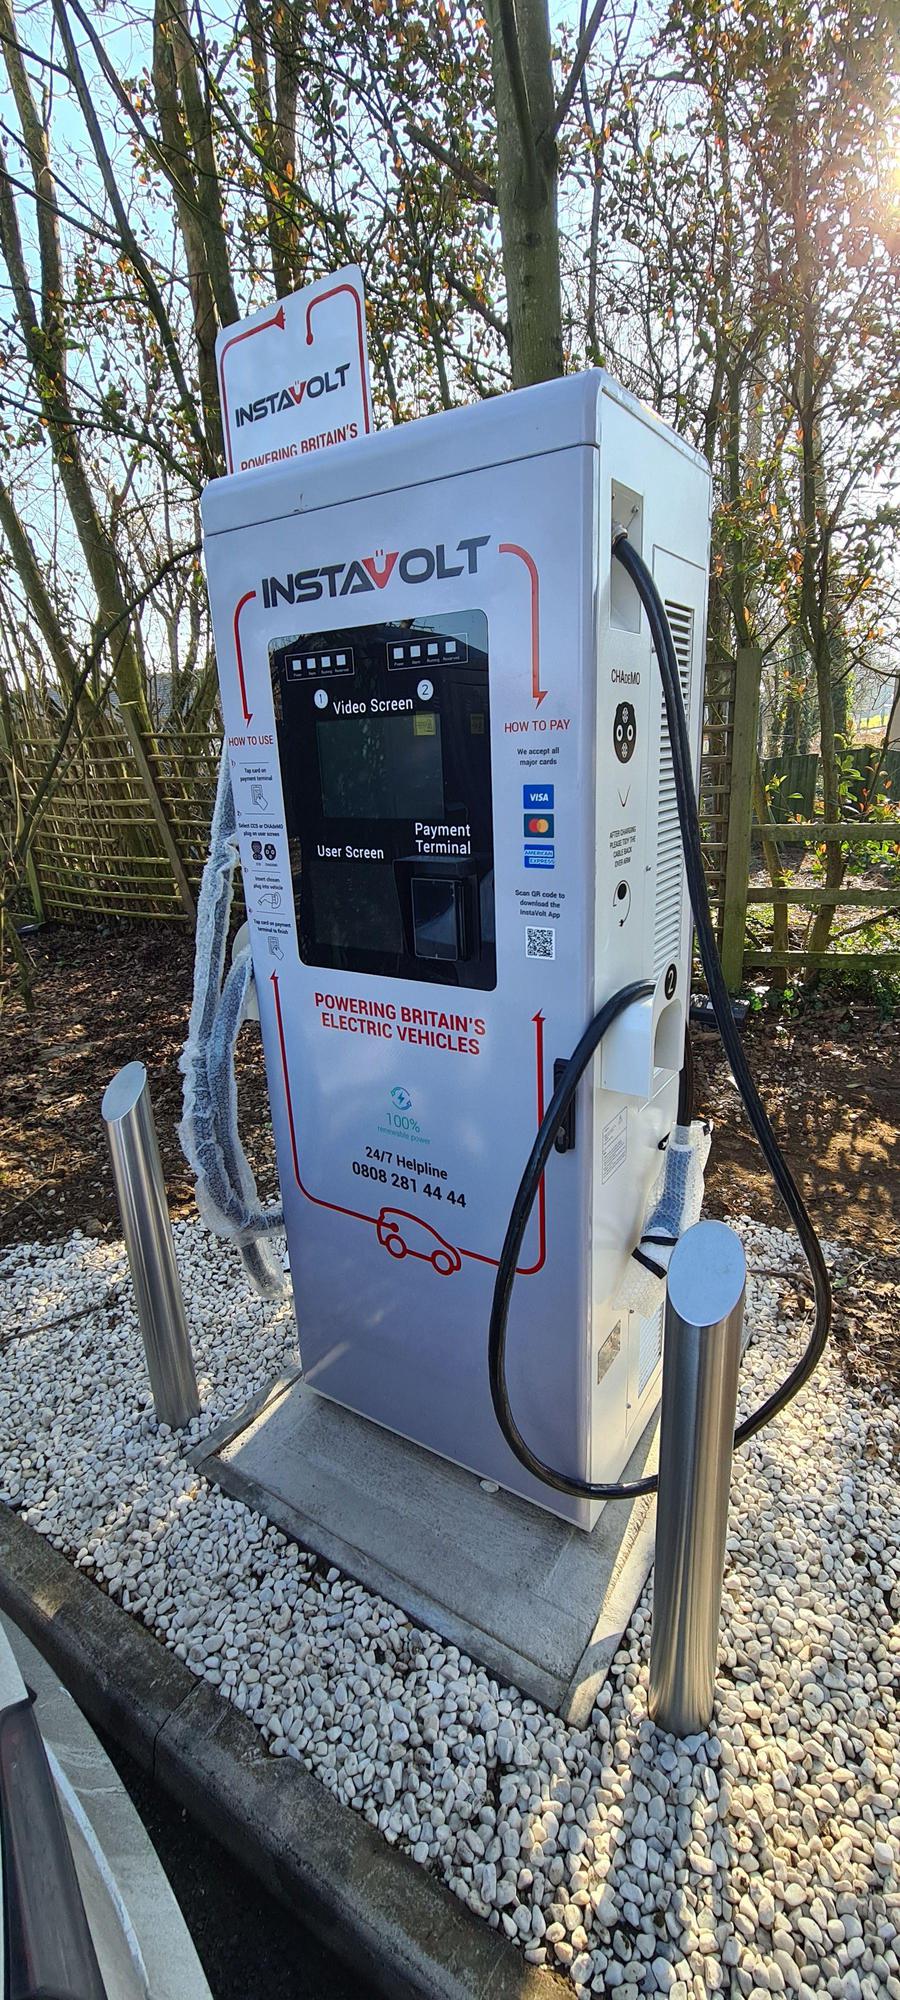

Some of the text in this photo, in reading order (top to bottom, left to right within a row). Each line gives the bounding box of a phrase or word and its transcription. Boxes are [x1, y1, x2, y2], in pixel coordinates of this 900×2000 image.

[235, 363, 350, 427] INSTAVOLT
[300, 423, 358, 453] BRITAIN'S
[261, 535, 491, 608] INSTAVOLT
[422, 684, 429, 695] 2
[333, 698, 413, 715] Video Screen
[504, 719, 571, 733] HOW TO PAY
[228, 735, 274, 746] HOW TO USE
[530, 794, 548, 802] VISA
[415, 822, 470, 839] Payment
[317, 845, 384, 859] User Screen
[415, 840, 471, 855] Terminal
[542, 891, 557, 899] code
[520, 900, 549, 908] download
[520, 909, 560, 919] InstaVolt App
[668, 970, 674, 994] 2
[314, 992, 486, 1035] POWERING BRITAIN'S
[321, 1012, 480, 1055] ELECTRIC VEHICLES
[386, 1112, 420, 1132] 100%
[365, 1146, 448, 1180] 24/7 Helpline
[352, 1162, 466, 1208] 0808 281 44 44
